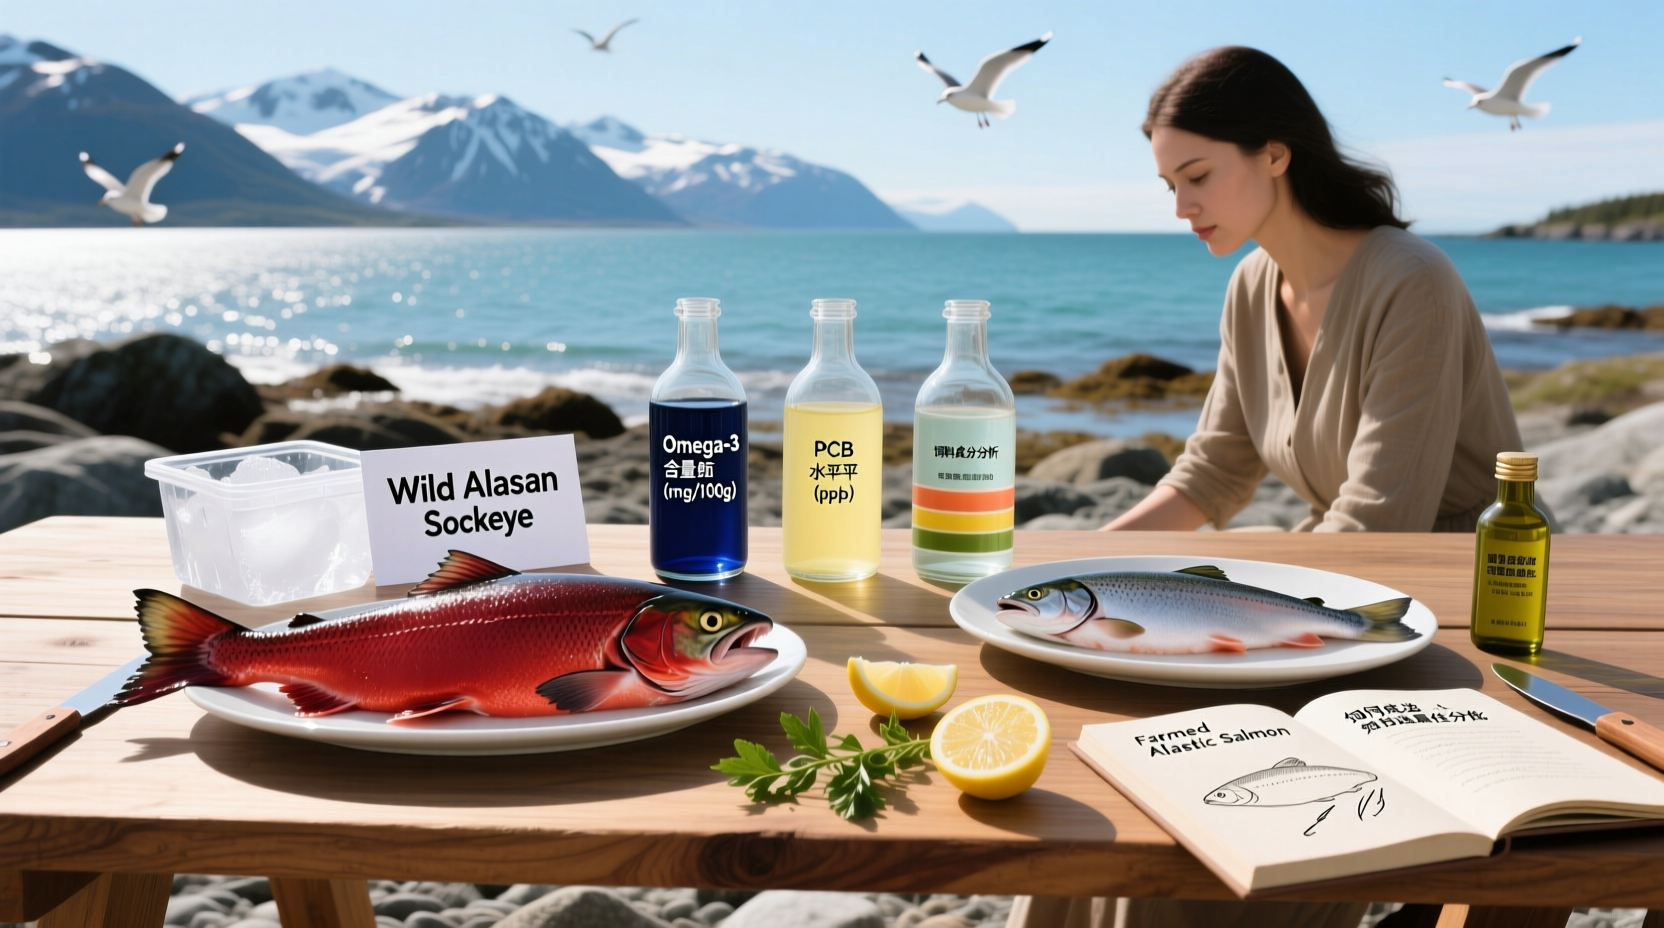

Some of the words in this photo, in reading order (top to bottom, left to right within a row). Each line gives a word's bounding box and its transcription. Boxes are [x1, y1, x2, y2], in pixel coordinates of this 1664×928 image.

[663, 434, 740, 459] Omega-3
[815, 440, 853, 457] PCB
[809, 462, 858, 481] 水平平
[387, 472, 455, 505] Wild
[463, 469, 558, 499] Alasan
[664, 481, 736, 503] (mg/100g)
[424, 505, 534, 537] Sockeye
[1134, 721, 1211, 746] Farmed
[1150, 738, 1217, 757] Alastic
[1219, 727, 1291, 744] Salmon
